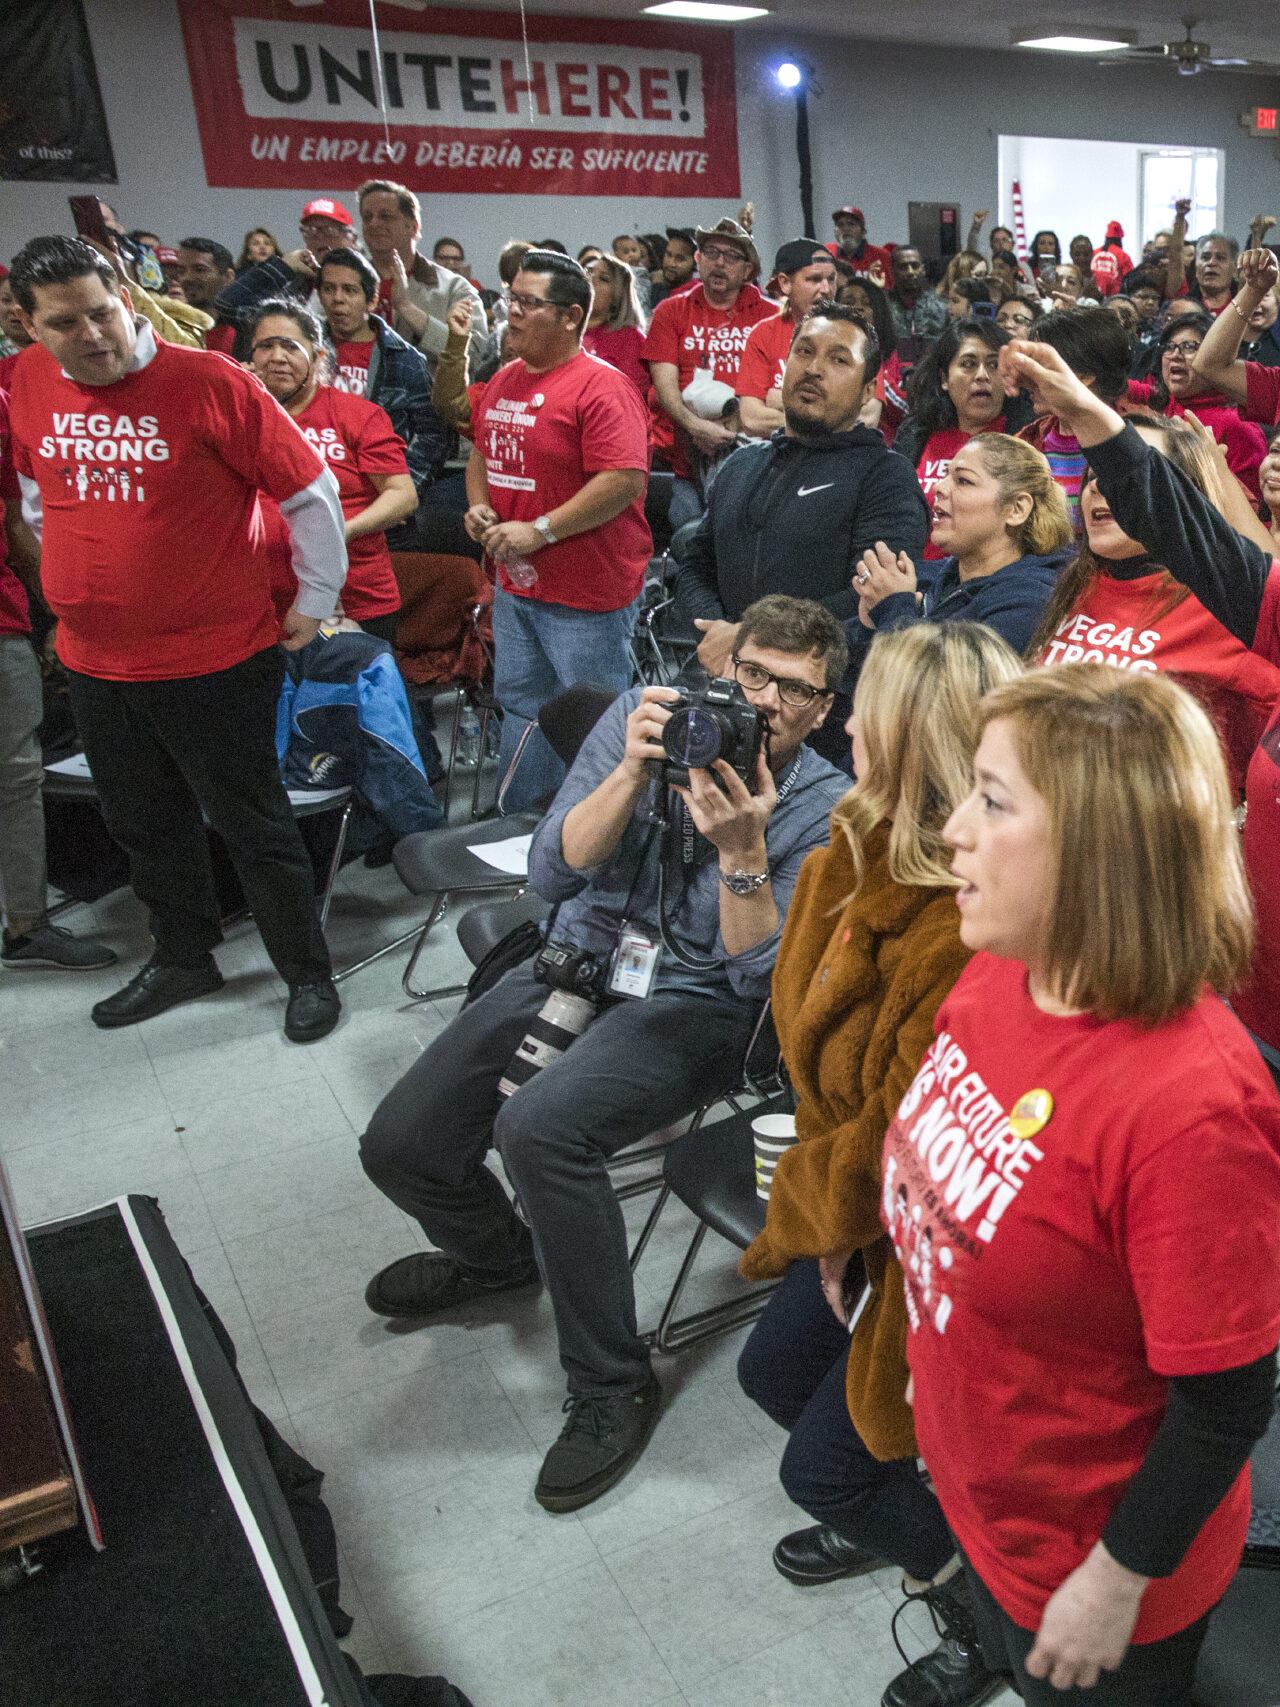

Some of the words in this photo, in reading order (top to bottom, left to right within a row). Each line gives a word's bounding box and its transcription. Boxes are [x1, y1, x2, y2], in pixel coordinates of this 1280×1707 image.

[19, 147, 33, 158] of
[38, 146, 73, 159] this?
[251, 133, 289, 162] UN
[300, 138, 405, 164] EMPLEO
[415, 138, 521, 168] DEBERÍA
[530, 147, 575, 170] SER
[582, 150, 710, 174] SUFICIENTE
[684, 337, 747, 351] STRON
[52, 413, 159, 437] VEGAS
[38, 436, 170, 462] STRONG
[1055, 614, 1161, 655] VEGAS
[683, 836, 694, 864] PRESS
[928, 1031, 967, 1092] UR
[951, 1072, 1044, 1189] FUTURE
[909, 1096, 1017, 1243] NOW!
